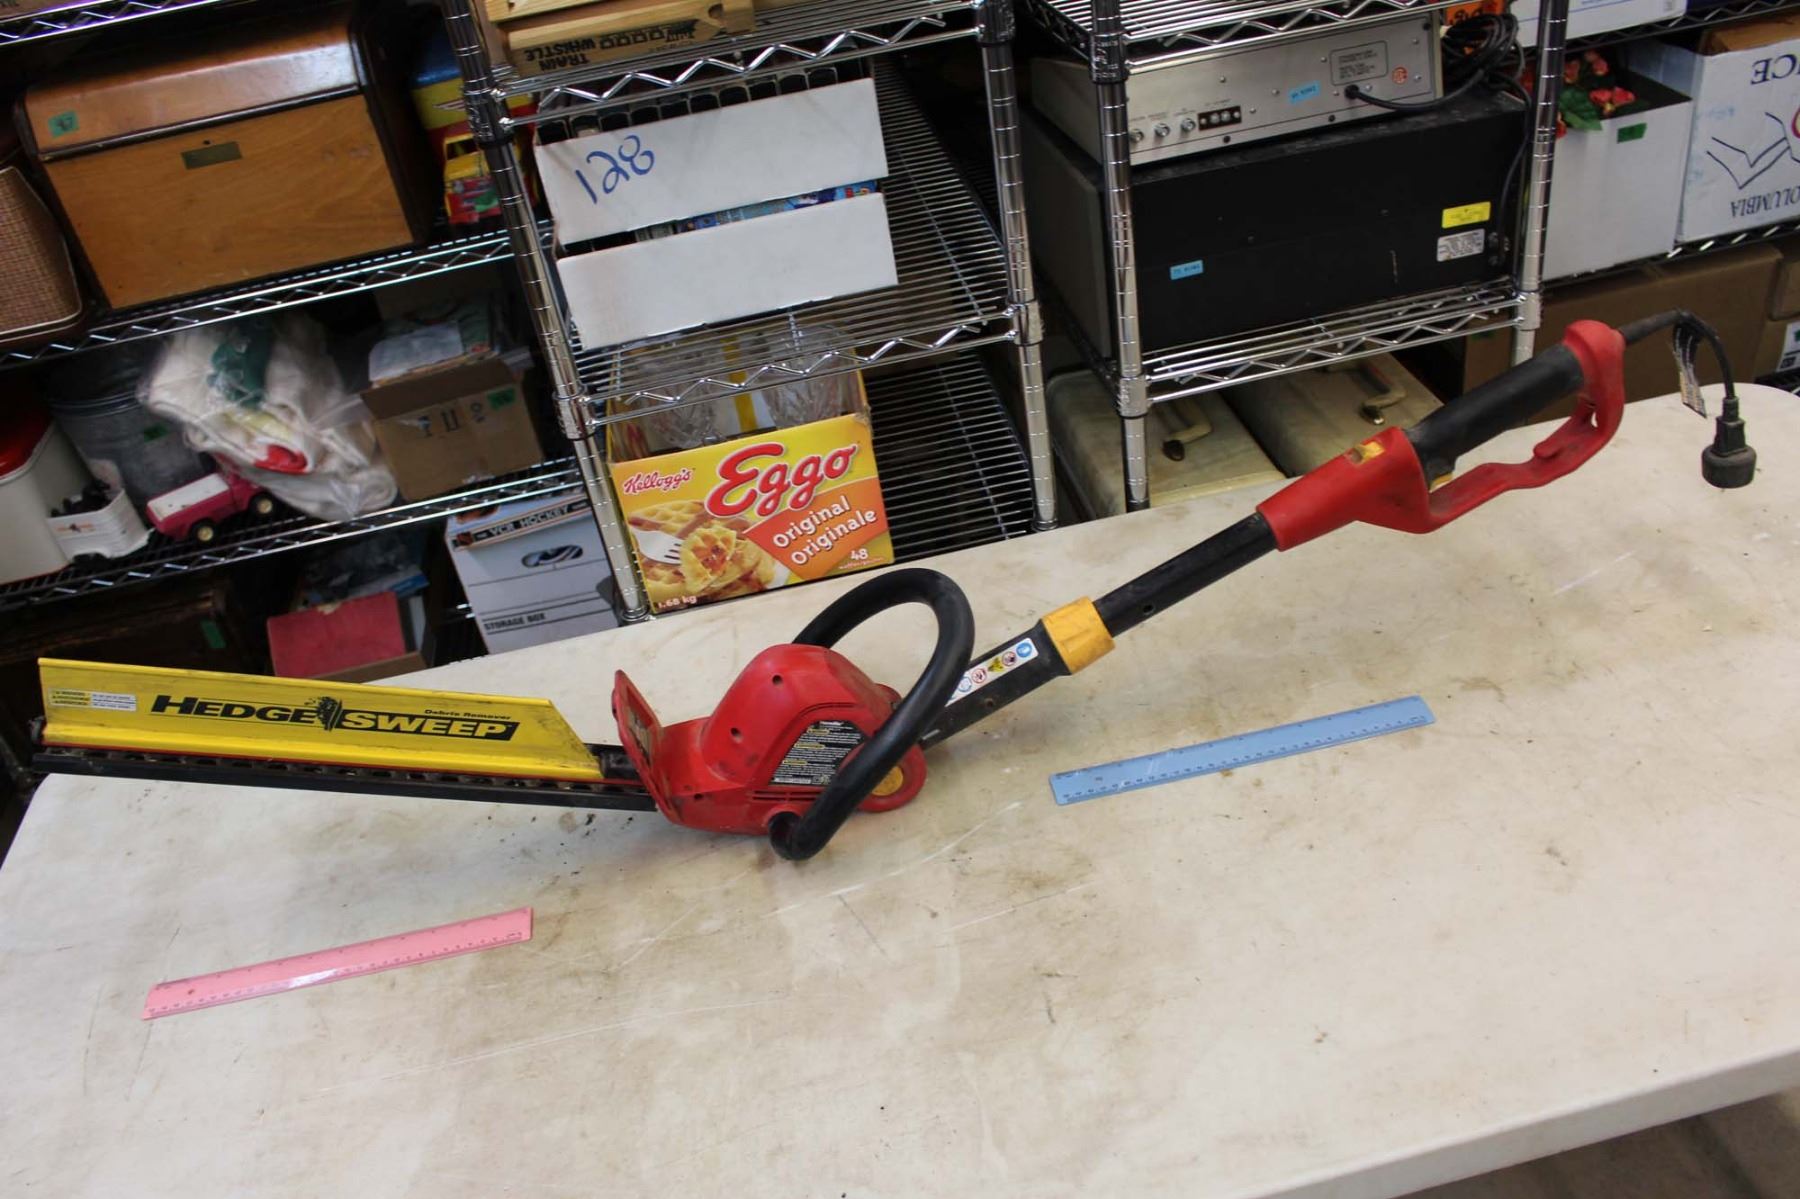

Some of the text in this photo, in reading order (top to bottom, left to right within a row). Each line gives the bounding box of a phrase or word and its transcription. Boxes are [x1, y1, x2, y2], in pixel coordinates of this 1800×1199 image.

[524, 38, 596, 61] WHISTLE
[539, 53, 590, 71] TRAIN
[1751, 54, 1800, 85] CE
[575, 134, 655, 205] 128
[623, 468, 694, 494] Kellogg's
[705, 442, 857, 519] Eggo
[520, 506, 569, 527] HOCKEY
[772, 495, 851, 548] Original
[791, 508, 877, 566] Originale
[851, 548, 869, 560] 48
[151, 694, 317, 724] HEDGE
[342, 712, 508, 738] SWEEP
